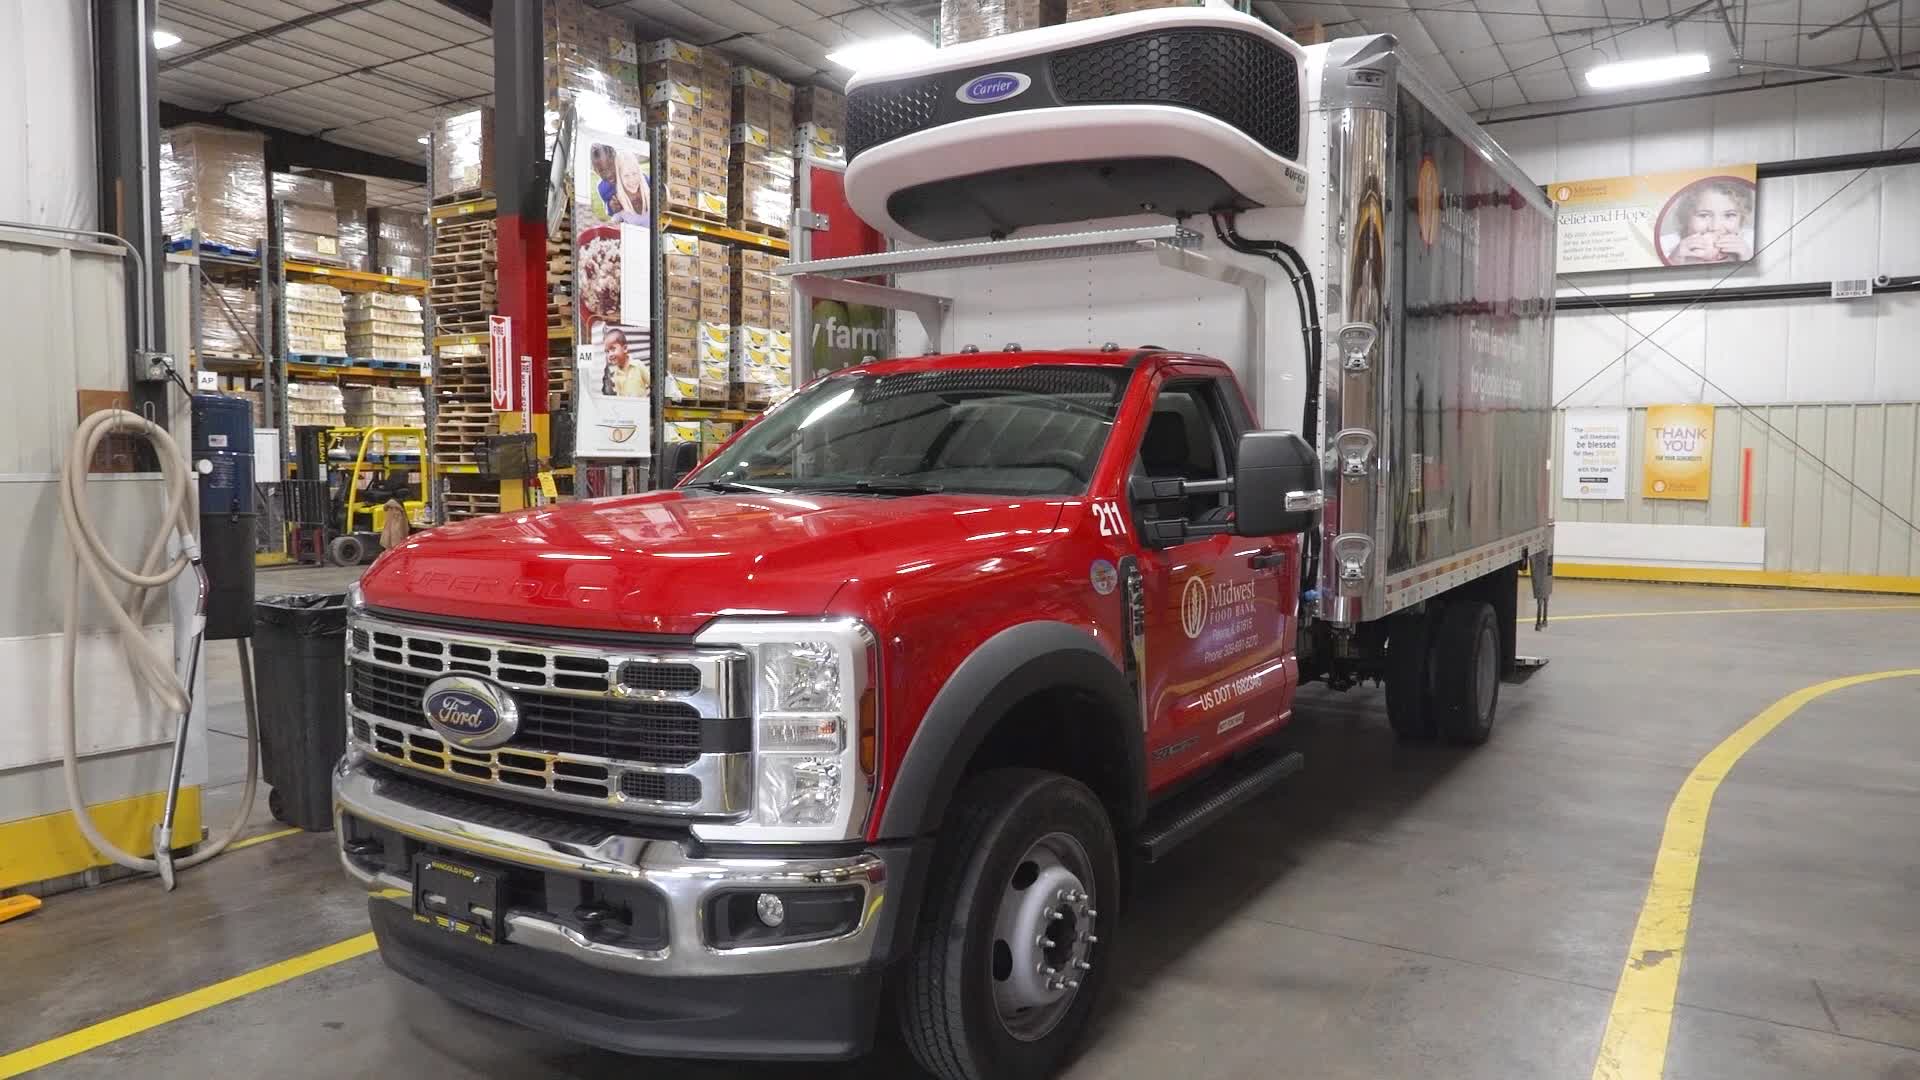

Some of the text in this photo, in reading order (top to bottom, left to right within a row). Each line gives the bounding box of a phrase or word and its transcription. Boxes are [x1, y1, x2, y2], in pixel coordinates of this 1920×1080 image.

[972, 80, 1013, 96] Carrier
[1589, 209, 1612, 223] and
[1615, 207, 1650, 225] Hope
[579, 352, 592, 361] AM
[1651, 428, 1708, 440] THANK
[1576, 441, 1616, 449] be blessed
[1664, 440, 1695, 452] YOU
[1091, 501, 1127, 536] 211
[1210, 578, 1256, 610] Midwest
[1209, 600, 1257, 625] FOOD BANK
[1199, 691, 1214, 711] US
[1213, 684, 1231, 705] DOT
[438, 695, 483, 728] Ford
